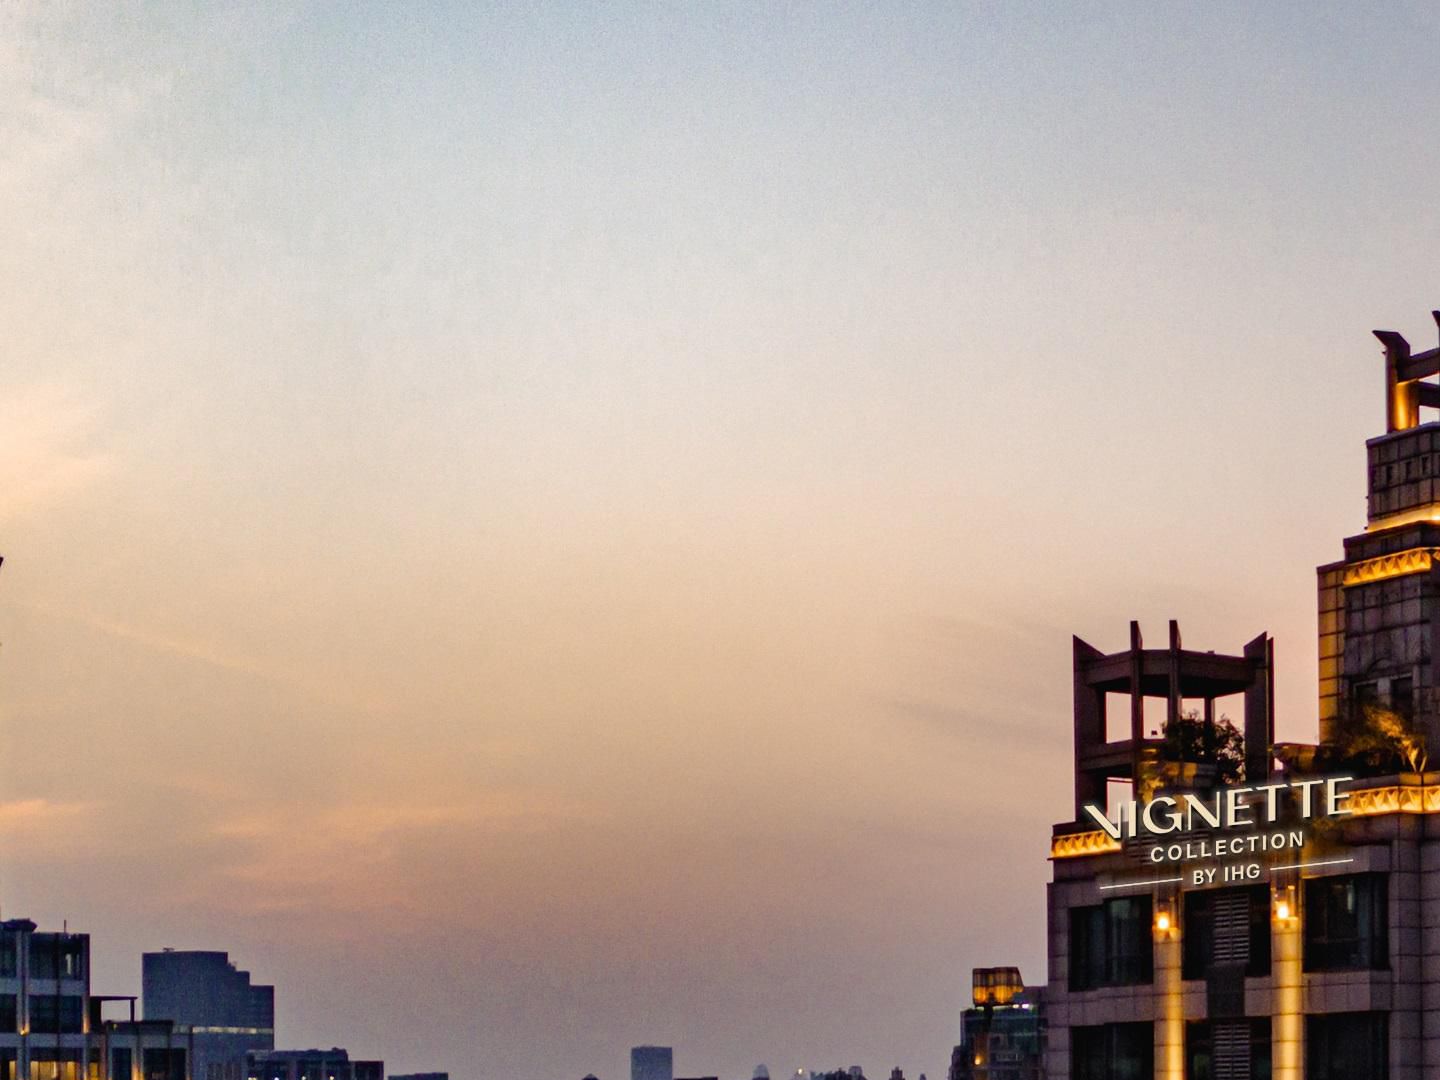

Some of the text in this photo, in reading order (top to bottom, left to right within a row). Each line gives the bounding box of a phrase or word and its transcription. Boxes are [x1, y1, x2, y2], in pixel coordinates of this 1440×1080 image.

[1084, 777, 1353, 839] VIGNETTE
[1150, 831, 1303, 863] COLLECTION
[1193, 863, 1261, 885] BY IHG
